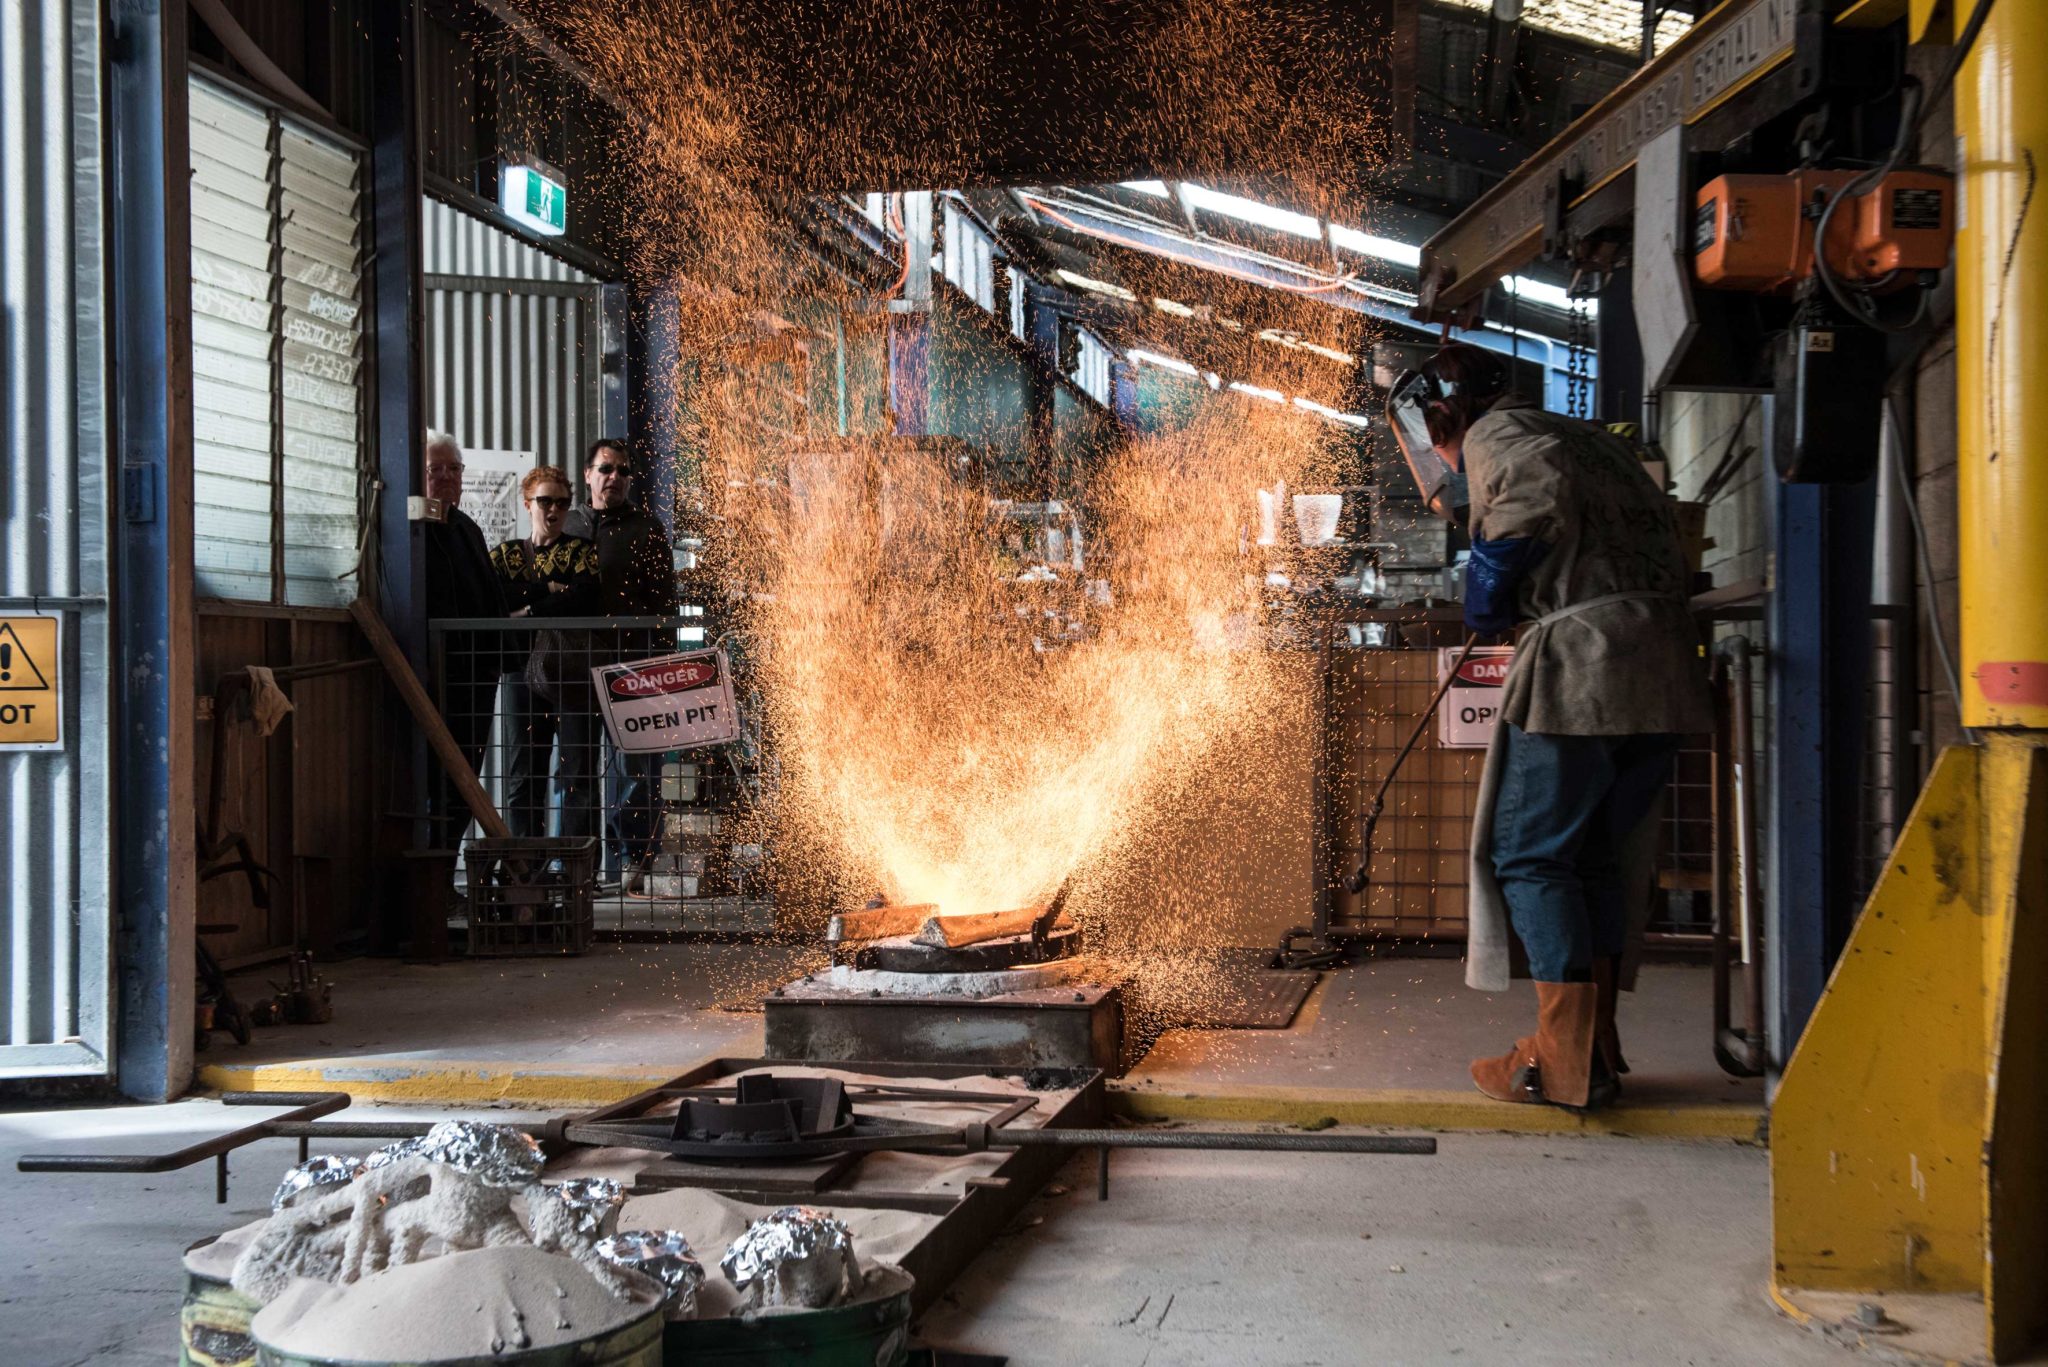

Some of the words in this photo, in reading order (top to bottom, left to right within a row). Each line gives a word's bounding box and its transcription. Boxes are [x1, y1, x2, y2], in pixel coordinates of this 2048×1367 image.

[1694, 15, 1758, 102] SERIAL
[625, 668, 700, 691] DANGER
[0, 704, 36, 724] OT
[624, 711, 680, 733] OPEN
[685, 705, 718, 724] PIT
